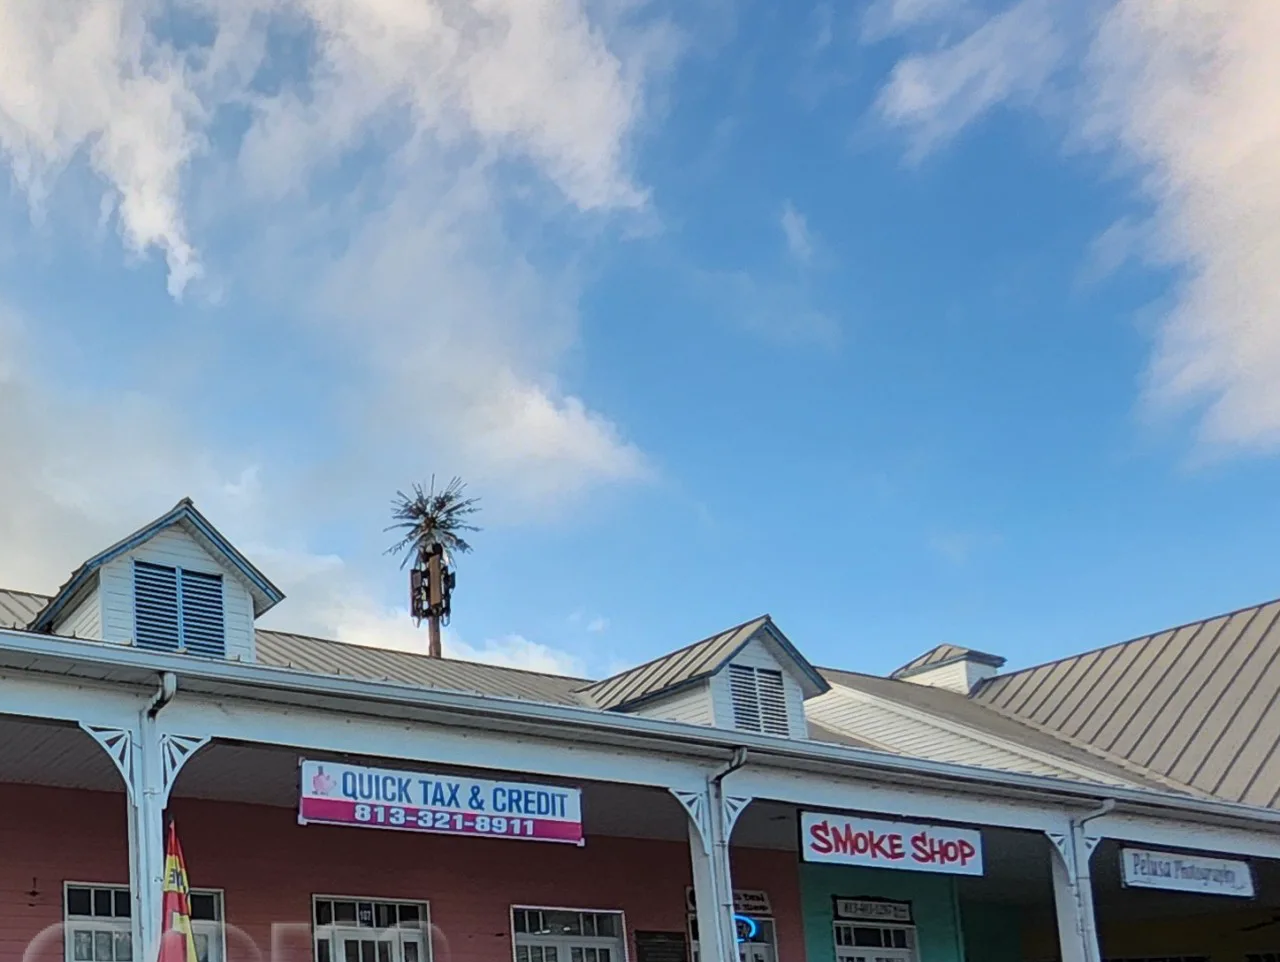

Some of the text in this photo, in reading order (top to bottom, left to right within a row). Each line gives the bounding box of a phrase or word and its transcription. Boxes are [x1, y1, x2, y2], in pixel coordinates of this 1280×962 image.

[342, 771, 569, 818] QUICK TAX & CREDIT
[354, 804, 535, 836] 813-321-8911
[810, 820, 976, 867] SMOKE SHOP
